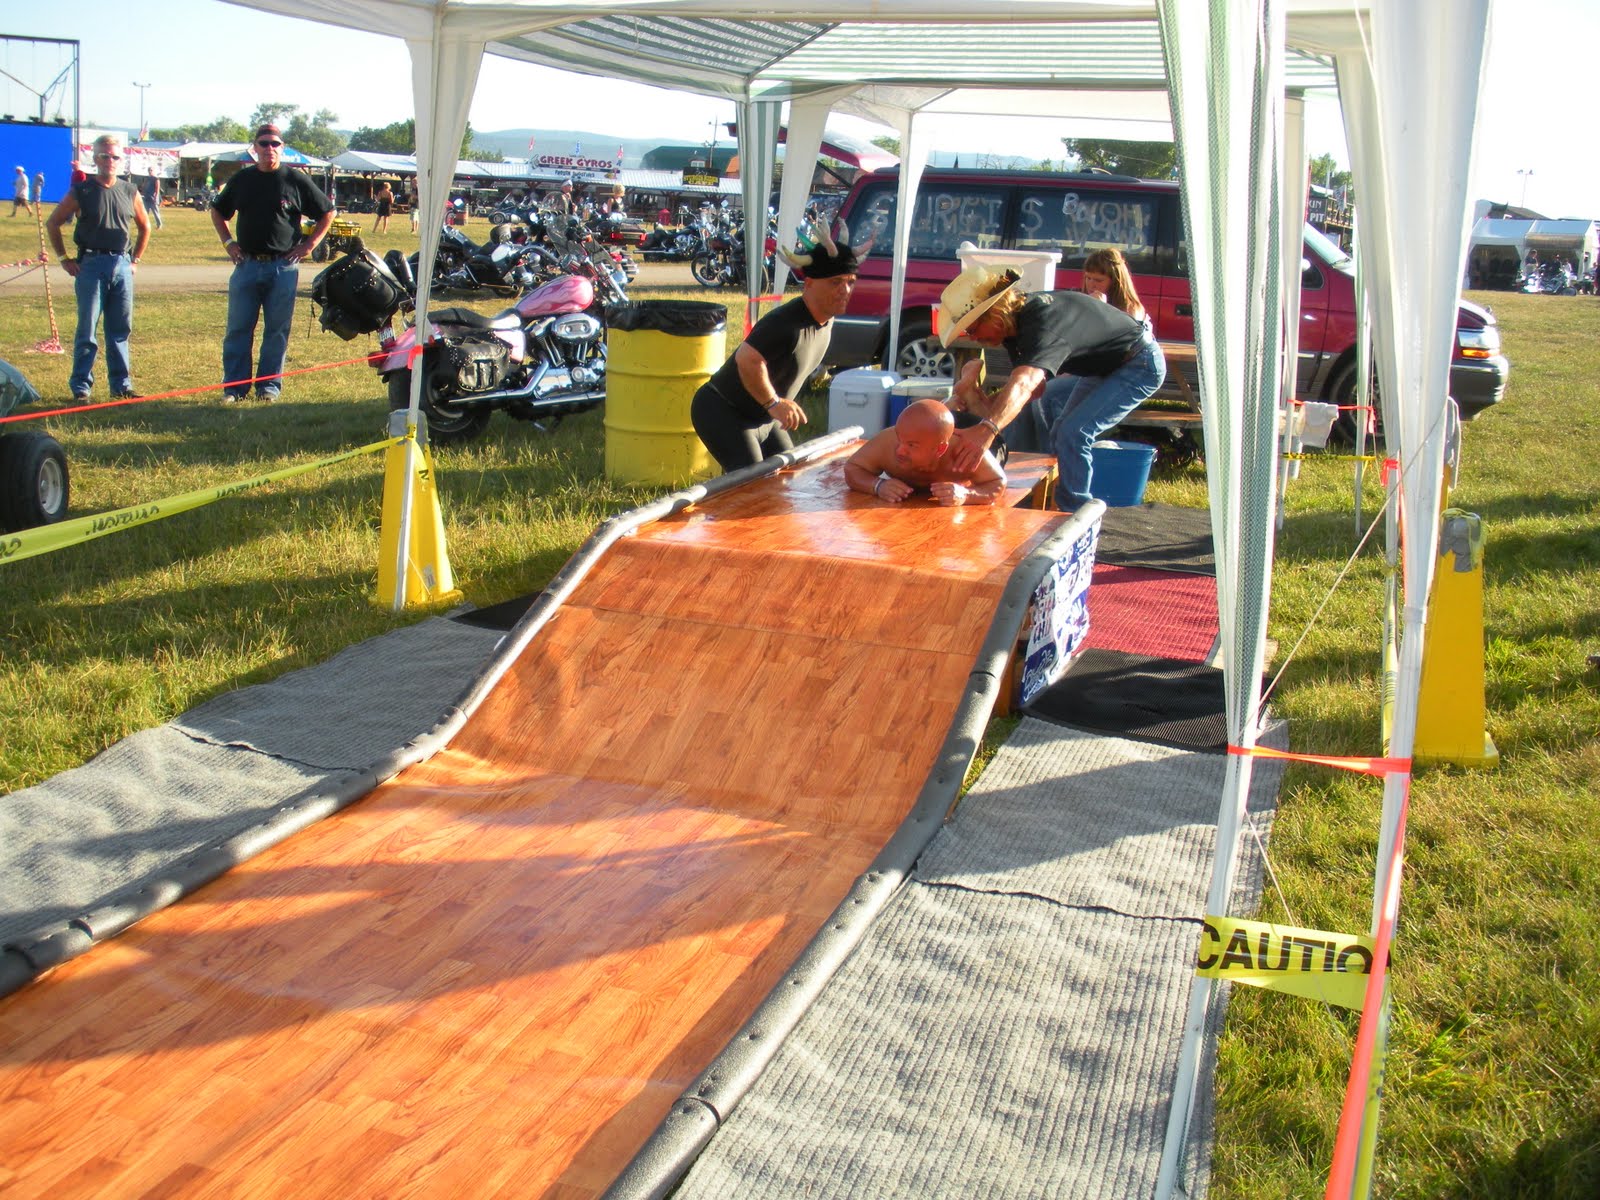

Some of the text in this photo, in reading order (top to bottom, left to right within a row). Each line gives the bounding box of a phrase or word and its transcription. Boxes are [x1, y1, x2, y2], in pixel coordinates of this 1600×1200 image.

[540, 155, 573, 165] GREEK
[576, 158, 612, 168] GYROS
[1310, 212, 1325, 222] PIT
[1197, 922, 1392, 975] CAUTIO
